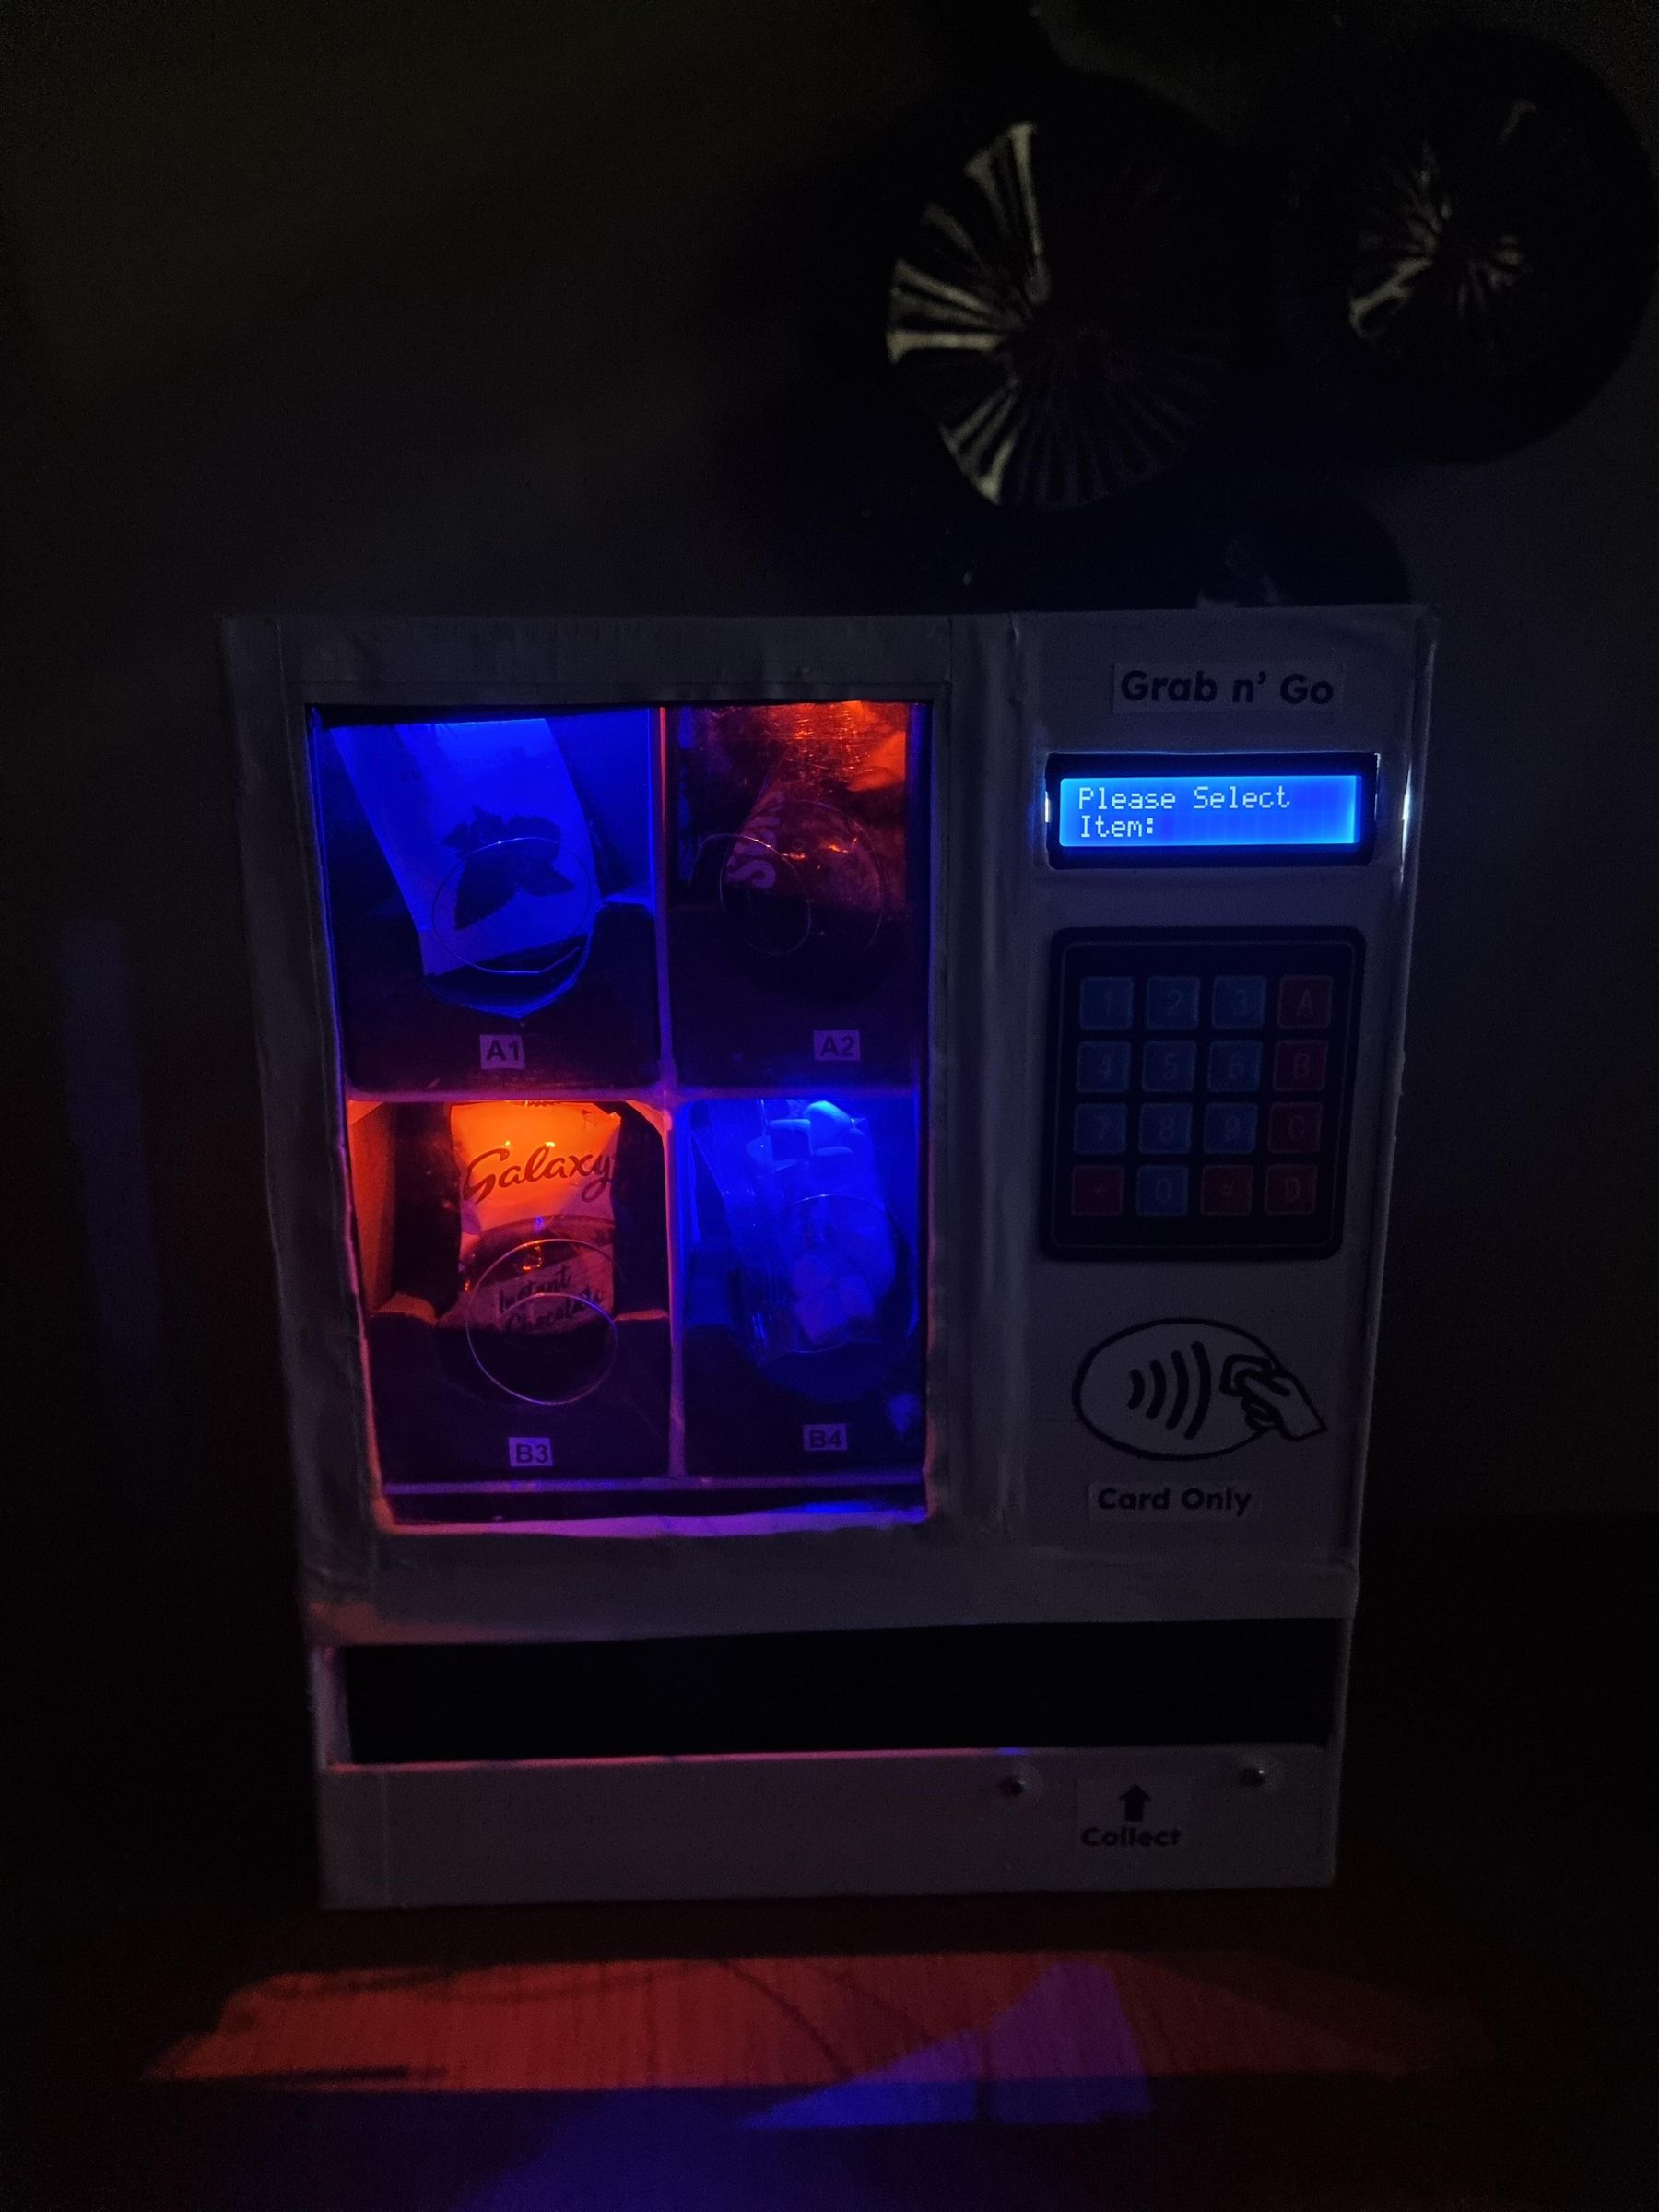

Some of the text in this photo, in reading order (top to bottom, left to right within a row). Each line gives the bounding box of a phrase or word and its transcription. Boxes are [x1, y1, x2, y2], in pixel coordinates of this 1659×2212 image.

[1121, 670, 1218, 702] Grab
[1280, 674, 1334, 705] Go
[1078, 785, 1290, 811] Please Select
[1081, 815, 1154, 838] Item:
[1166, 989, 1182, 1018] 2
[1296, 988, 1315, 1017] A
[486, 1040, 521, 1062] A1
[820, 1036, 855, 1057] A2
[463, 1145, 614, 1204] Galaxy
[808, 1430, 842, 1449] B4
[515, 1442, 550, 1464] B3
[1098, 1488, 1252, 1516] Card Only
[1081, 1826, 1181, 1848] Collect
